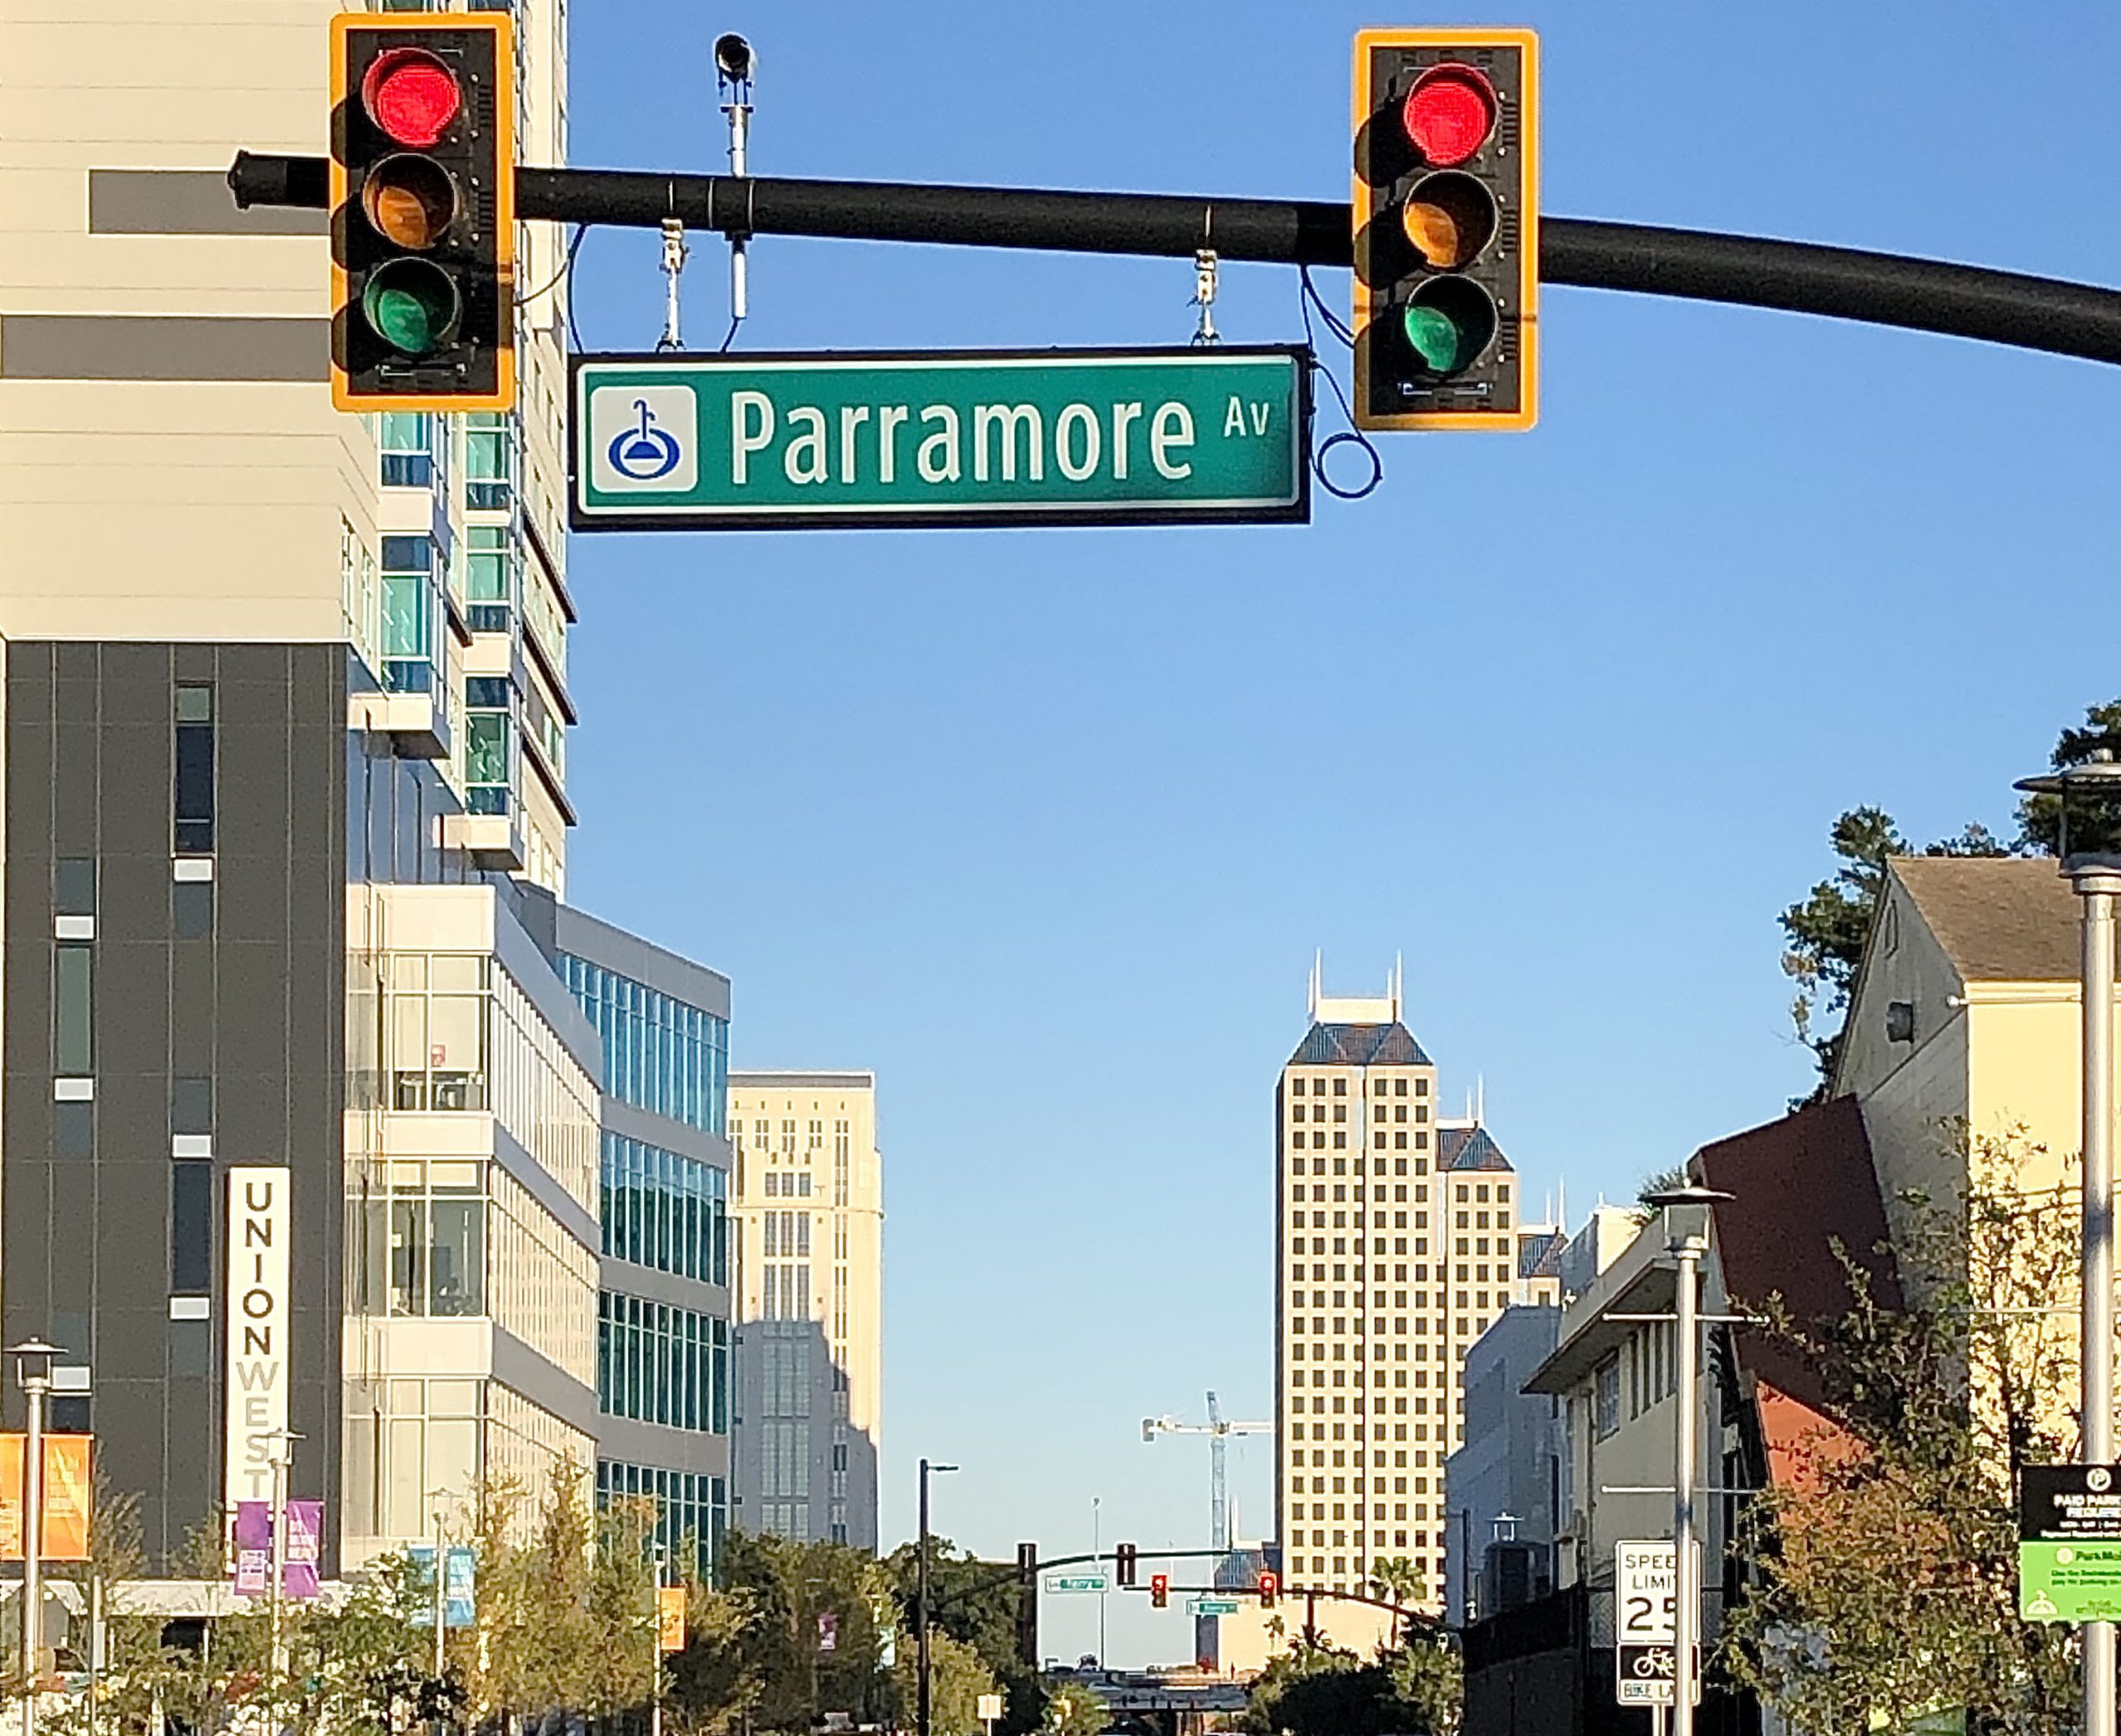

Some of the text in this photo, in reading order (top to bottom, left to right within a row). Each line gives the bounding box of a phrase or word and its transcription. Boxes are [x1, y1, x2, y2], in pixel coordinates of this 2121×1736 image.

[731, 391, 1271, 485] Parramore Av
[1626, 1553, 1676, 1569] SPEE
[1632, 1574, 1675, 1589] LIMI
